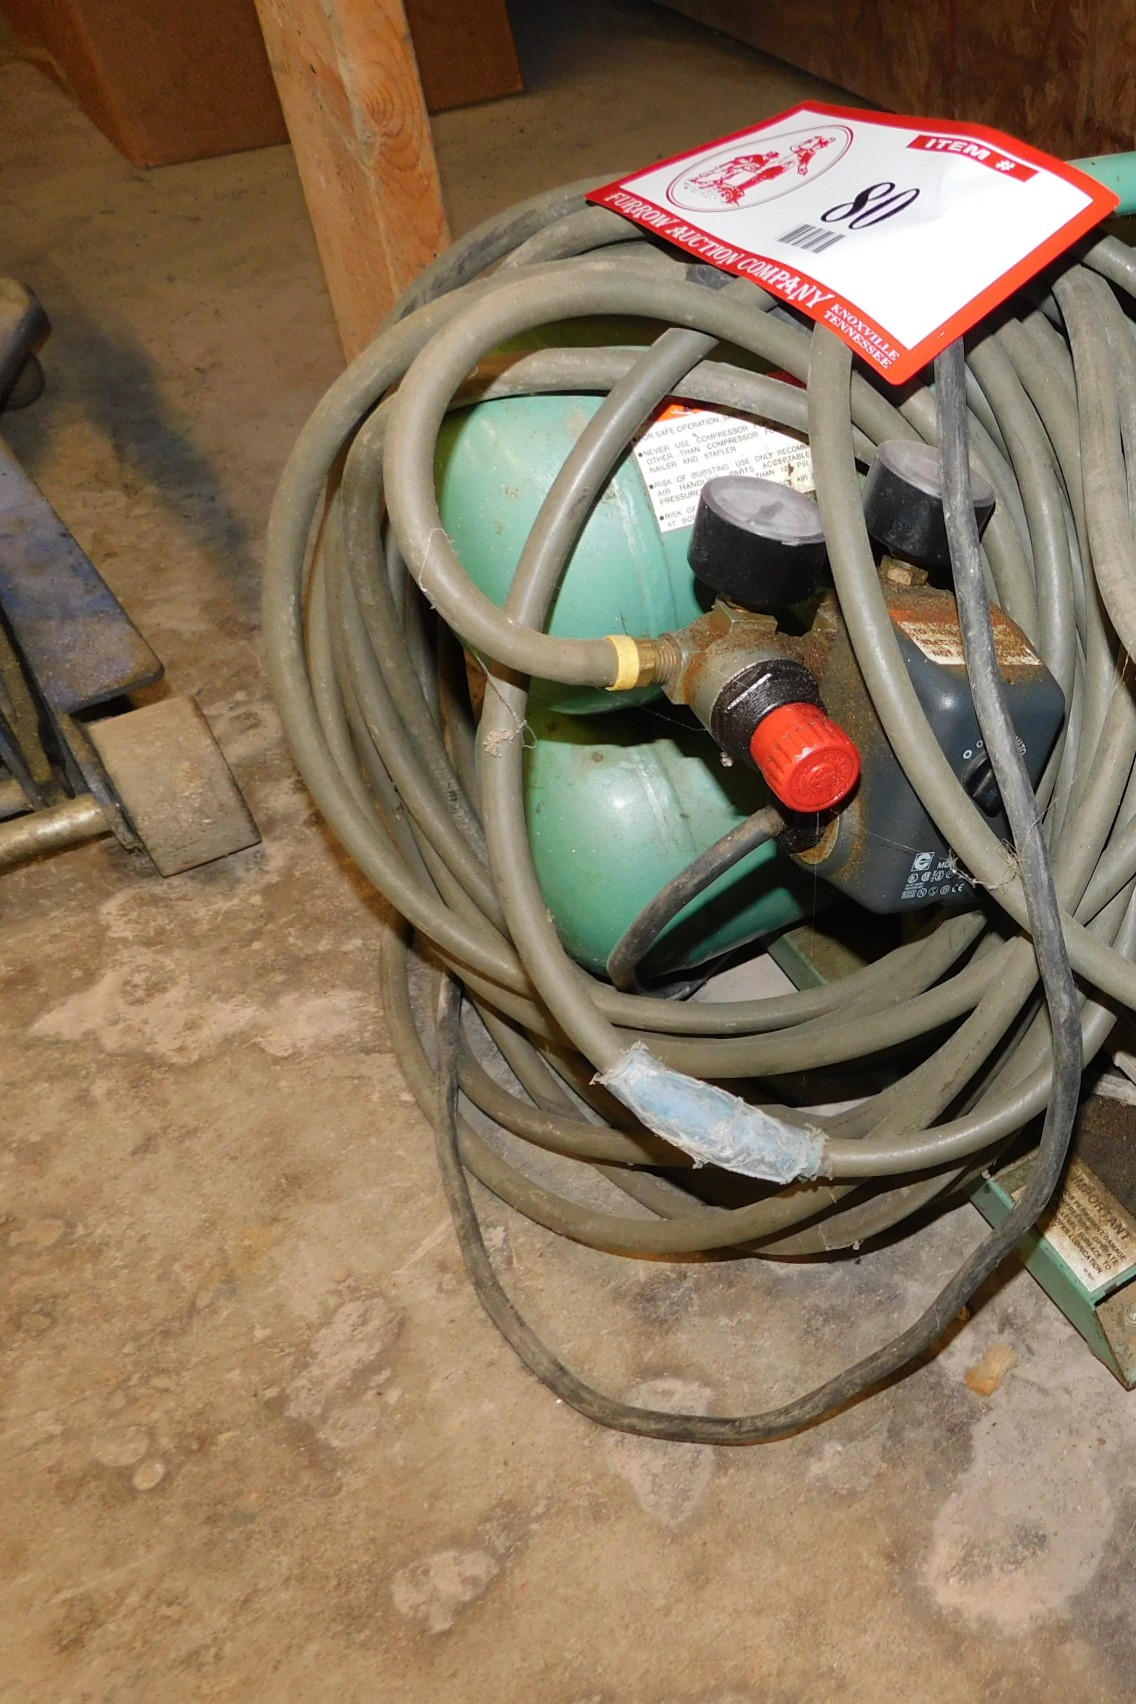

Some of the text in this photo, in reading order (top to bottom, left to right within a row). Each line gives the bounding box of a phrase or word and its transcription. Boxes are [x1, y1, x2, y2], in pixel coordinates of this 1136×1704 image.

[925, 138, 1016, 172] ITEM #
[820, 182, 920, 229] 80
[604, 192, 835, 309] FURROW AUCTION COMPANY
[823, 310, 892, 369] TENNESSEE
[831, 304, 900, 361] KNOXVILLE
[643, 425, 748, 456] NEVER USE COMPRESSOR
[646, 452, 673, 465] OTHER
[680, 446, 700, 456] THAN
[706, 430, 758, 450] COMPRESSOR
[655, 426, 675, 438] SAFE
[649, 446, 736, 473] NAILER AND STAPLER
[654, 478, 672, 488] RISK
[691, 464, 729, 478] BURSTING
[735, 458, 750, 467] USE
[754, 452, 773, 462] ONLY
[658, 488, 671, 496] AIR
[762, 451, 810, 469] ACCEPTABLE
[664, 511, 682, 519] RISK
[1072, 1175, 1132, 1240] IMPORTANT
[1077, 1232, 1101, 1258] SURFACE
[1102, 1262, 1111, 1270] TO
[1103, 1235, 1126, 1260] DAMAGE
